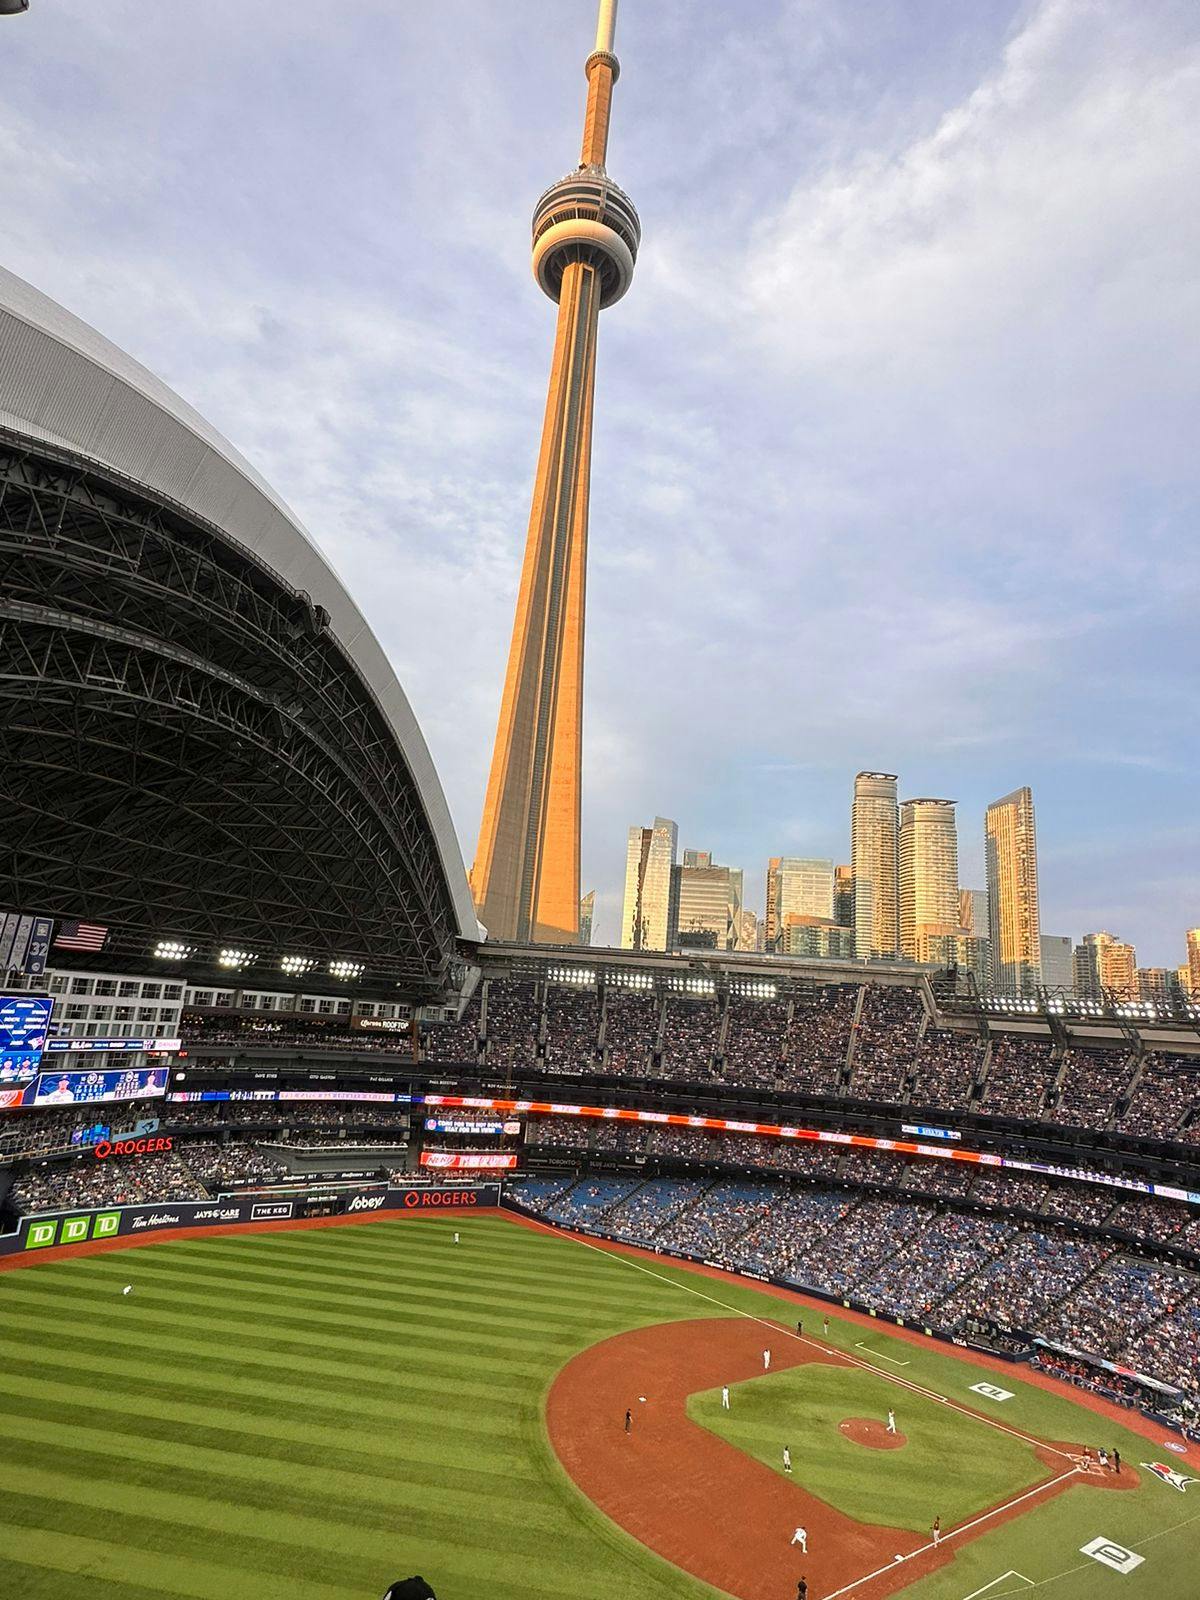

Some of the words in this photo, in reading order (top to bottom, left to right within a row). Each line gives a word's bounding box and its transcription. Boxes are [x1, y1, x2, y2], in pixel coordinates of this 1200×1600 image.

[30, 941, 48, 956] 32
[382, 1021, 409, 1029] ROOFTOP
[114, 1137, 173, 1155] ROGERS
[549, 1158, 576, 1166] TORONTO
[348, 1195, 386, 1212] Sobeys
[422, 1192, 477, 1206] ROGERS
[194, 1209, 213, 1219] JAYS
[220, 1208, 240, 1217] CARE
[274, 1206, 288, 1214] KEG
[98, 1215, 118, 1232] TD
[131, 1216, 147, 1229] Tim
[147, 1213, 180, 1226] Hortons
[31, 1224, 53, 1243] TD
[65, 1220, 86, 1238] TD
[997, 1322, 1012, 1334] VISA
[951, 1336, 968, 1348] VISA
